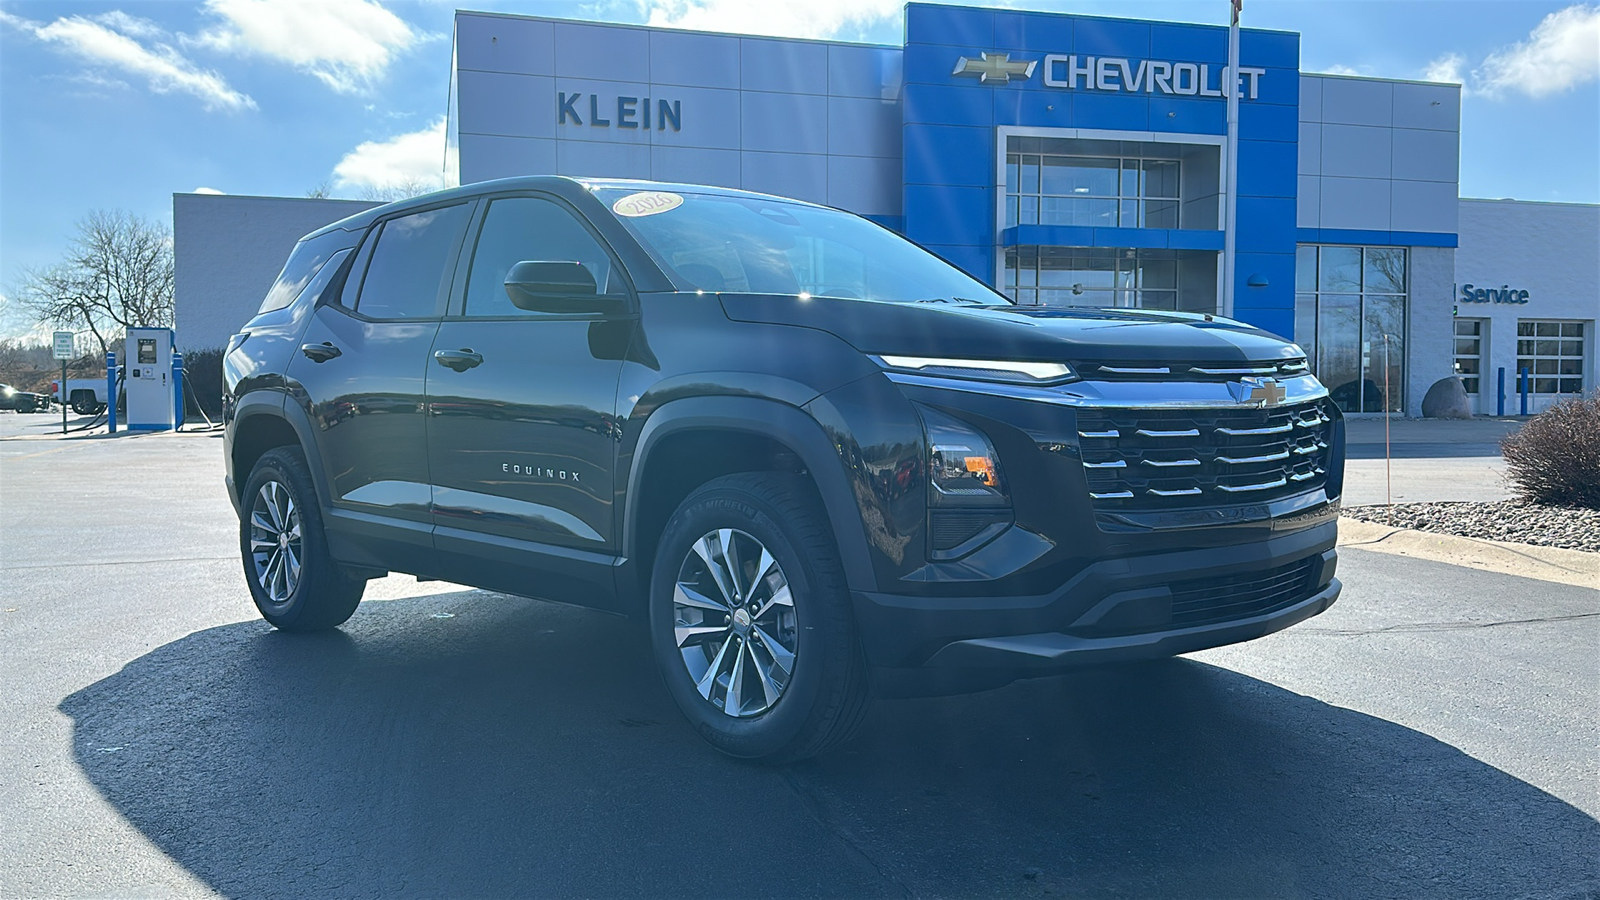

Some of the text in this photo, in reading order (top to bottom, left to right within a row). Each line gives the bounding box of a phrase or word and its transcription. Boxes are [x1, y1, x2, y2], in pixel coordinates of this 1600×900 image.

[1043, 53, 1266, 99] CHEVROLET
[558, 91, 681, 132] KLEIN
[626, 194, 673, 214] 2026
[1461, 283, 1529, 304] Service
[502, 463, 580, 482] EQUINOX
[705, 500, 755, 518] MICHELIN
